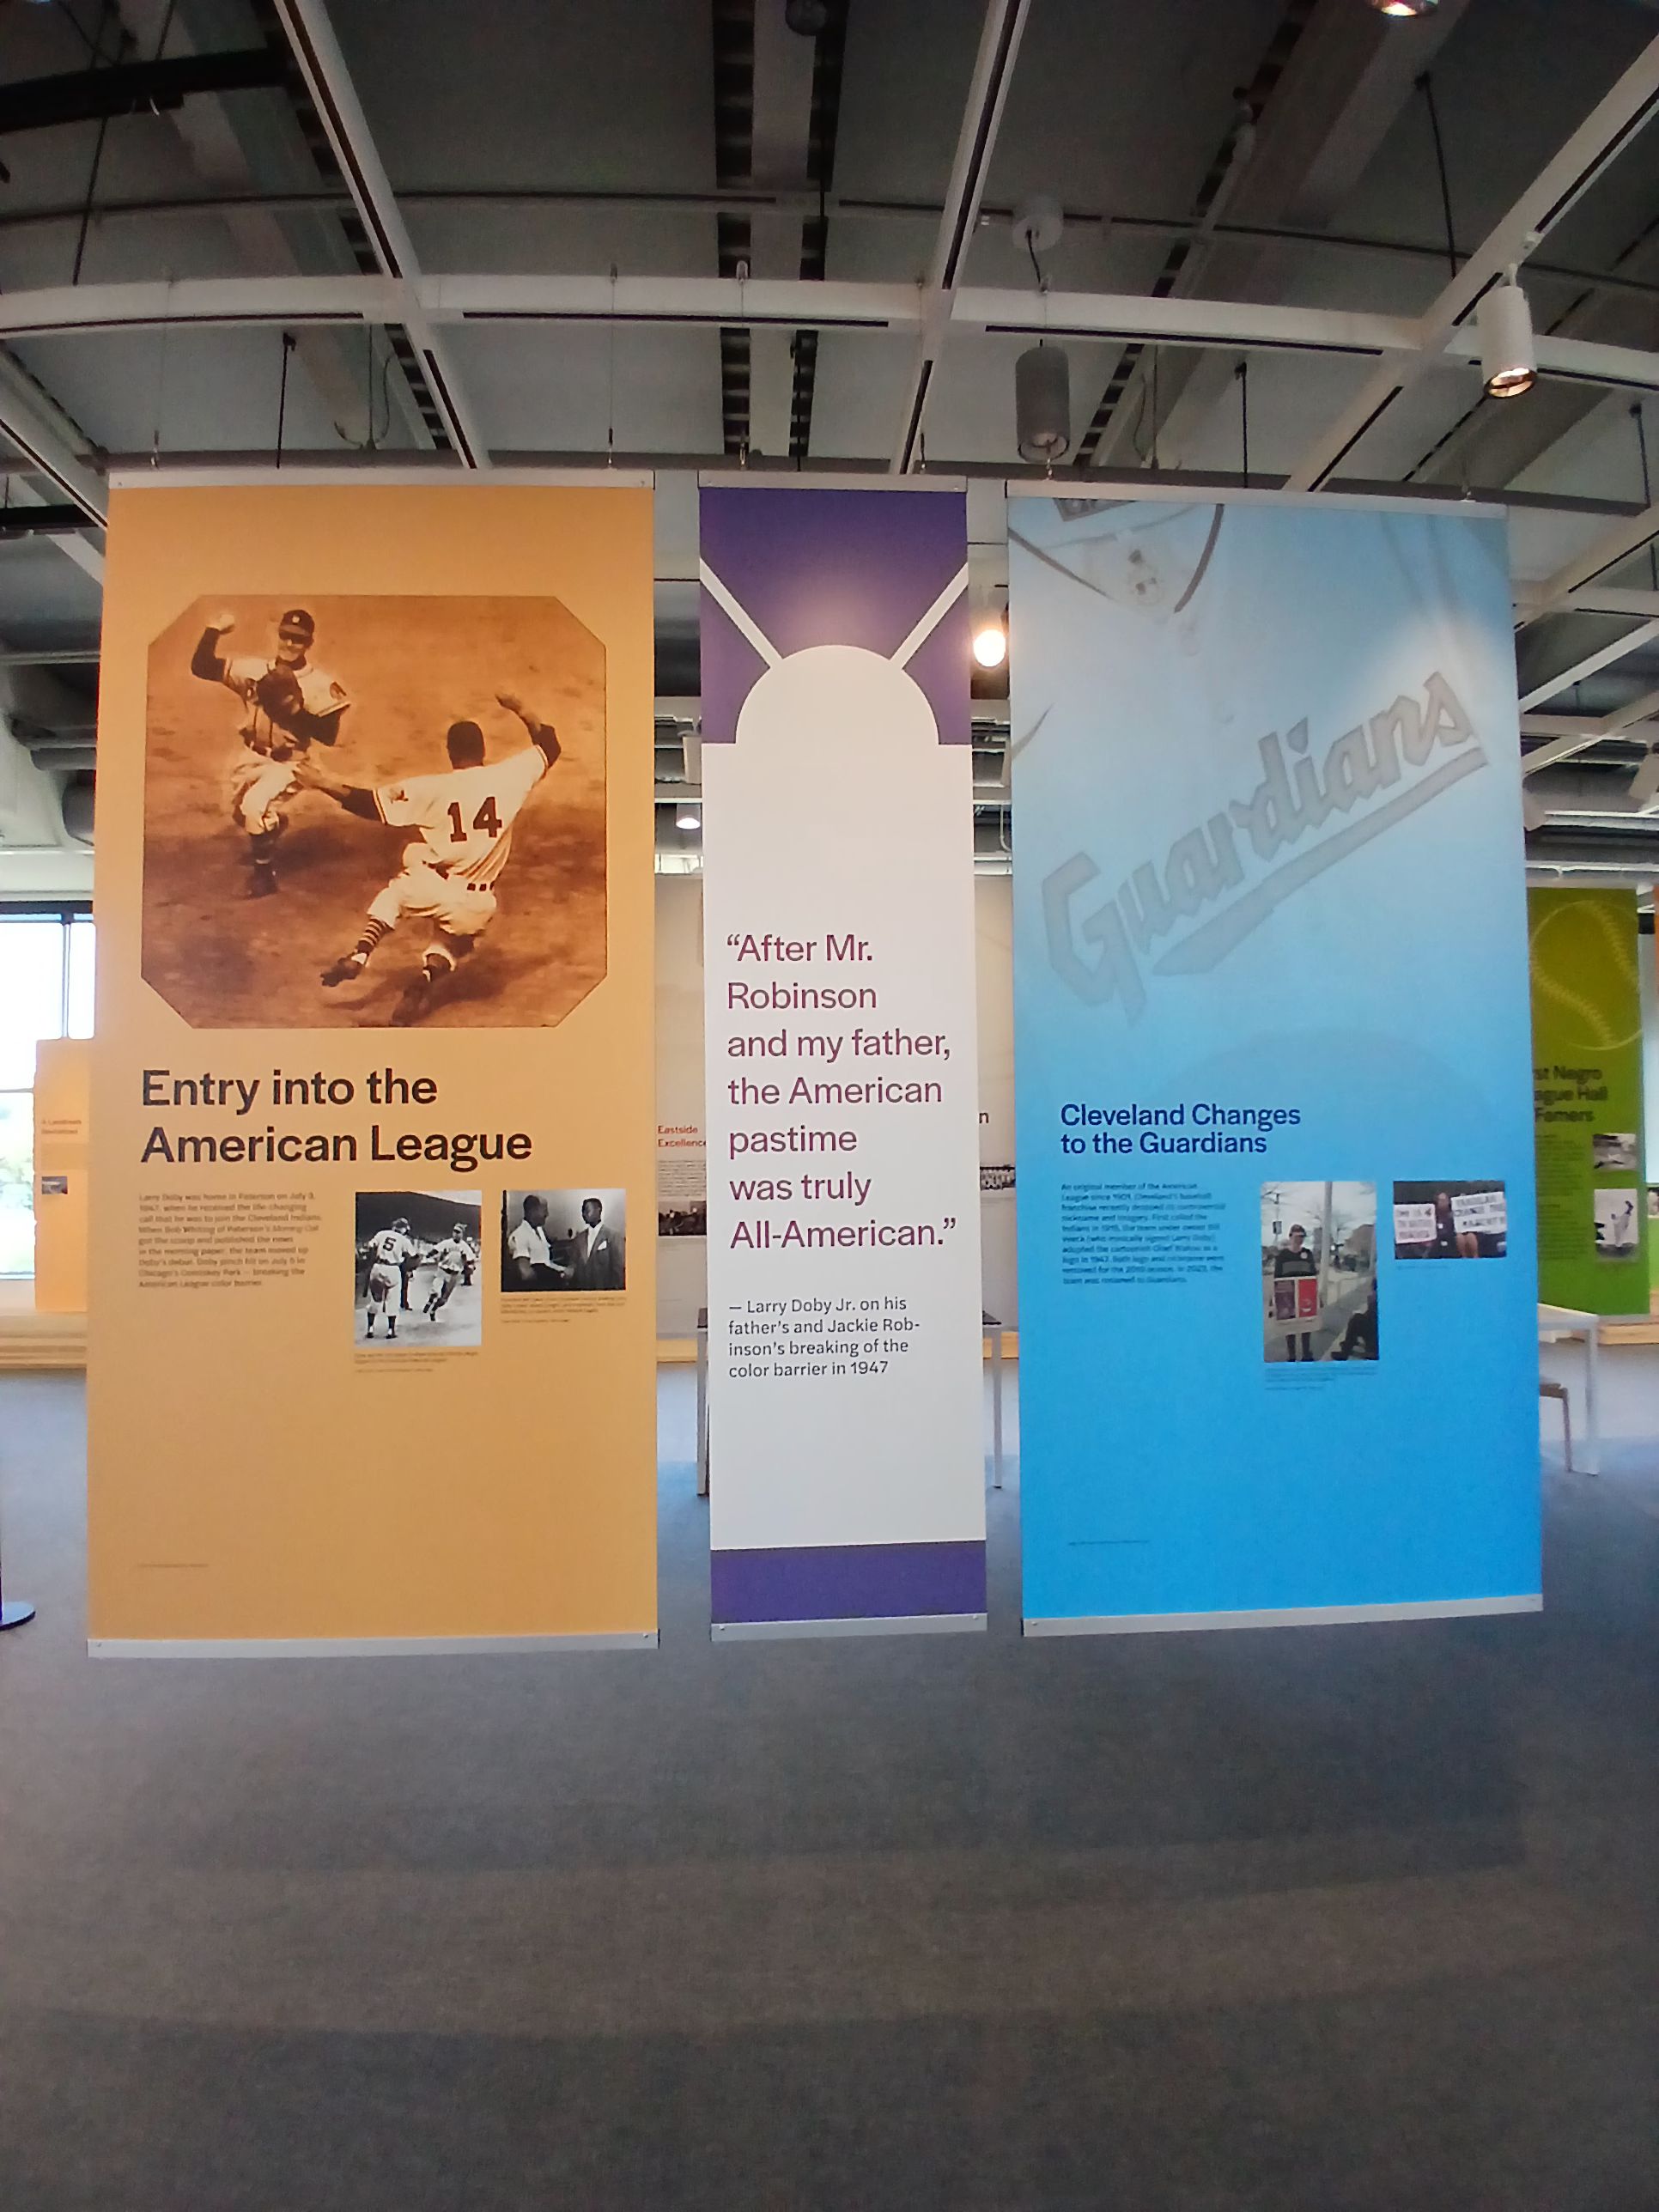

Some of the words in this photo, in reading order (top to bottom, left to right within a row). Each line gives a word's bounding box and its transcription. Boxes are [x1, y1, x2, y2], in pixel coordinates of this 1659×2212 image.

[447, 796, 502, 842] 14
[1042, 672, 1474, 1029] Guardians
[727, 934, 817, 961] “After
[827, 934, 872, 961] Mr.
[729, 981, 876, 1009] Robinson
[728, 1029, 787, 1056] and
[799, 1036, 843, 1063] my
[852, 1028, 950, 1060] father,
[1553, 1065, 1602, 1085] Negro
[143, 1070, 260, 1115] Entry
[274, 1070, 354, 1104] into
[367, 1068, 437, 1103] the
[728, 1077, 780, 1104] the
[789, 1077, 941, 1103] American
[658, 1126, 698, 1134] Eastside
[1061, 1103, 1184, 1126] Cleveland
[1192, 1103, 1301, 1132] Changes
[141, 1126, 356, 1163] American
[372, 1125, 532, 1172] League
[731, 1125, 856, 1159] pastime
[1061, 1134, 1085, 1153] to
[1092, 1132, 1132, 1153] the
[1139, 1131, 1267, 1154] Guardians
[730, 1180, 792, 1200] was
[801, 1171, 871, 1206] truly
[381, 1237, 396, 1251] 5
[731, 1218, 956, 1249] All-American.”
[748, 1301, 787, 1316] Larry
[793, 1298, 831, 1315] Doby
[836, 1298, 855, 1310] Jr.
[860, 1301, 878, 1310] on
[885, 1297, 906, 1310] his
[729, 1321, 789, 1334] father’s
[794, 1319, 823, 1333] and
[828, 1318, 878, 1332] Jackie
[884, 1317, 920, 1331] Rob-
[730, 1342, 784, 1356] inson’s
[790, 1340, 859, 1357] breaking
[864, 1339, 878, 1352] of
[884, 1339, 908, 1352] the
[730, 1364, 769, 1377] color
[775, 1363, 827, 1376] barrier
[833, 1362, 845, 1374] in
[851, 1361, 888, 1374] 1947
